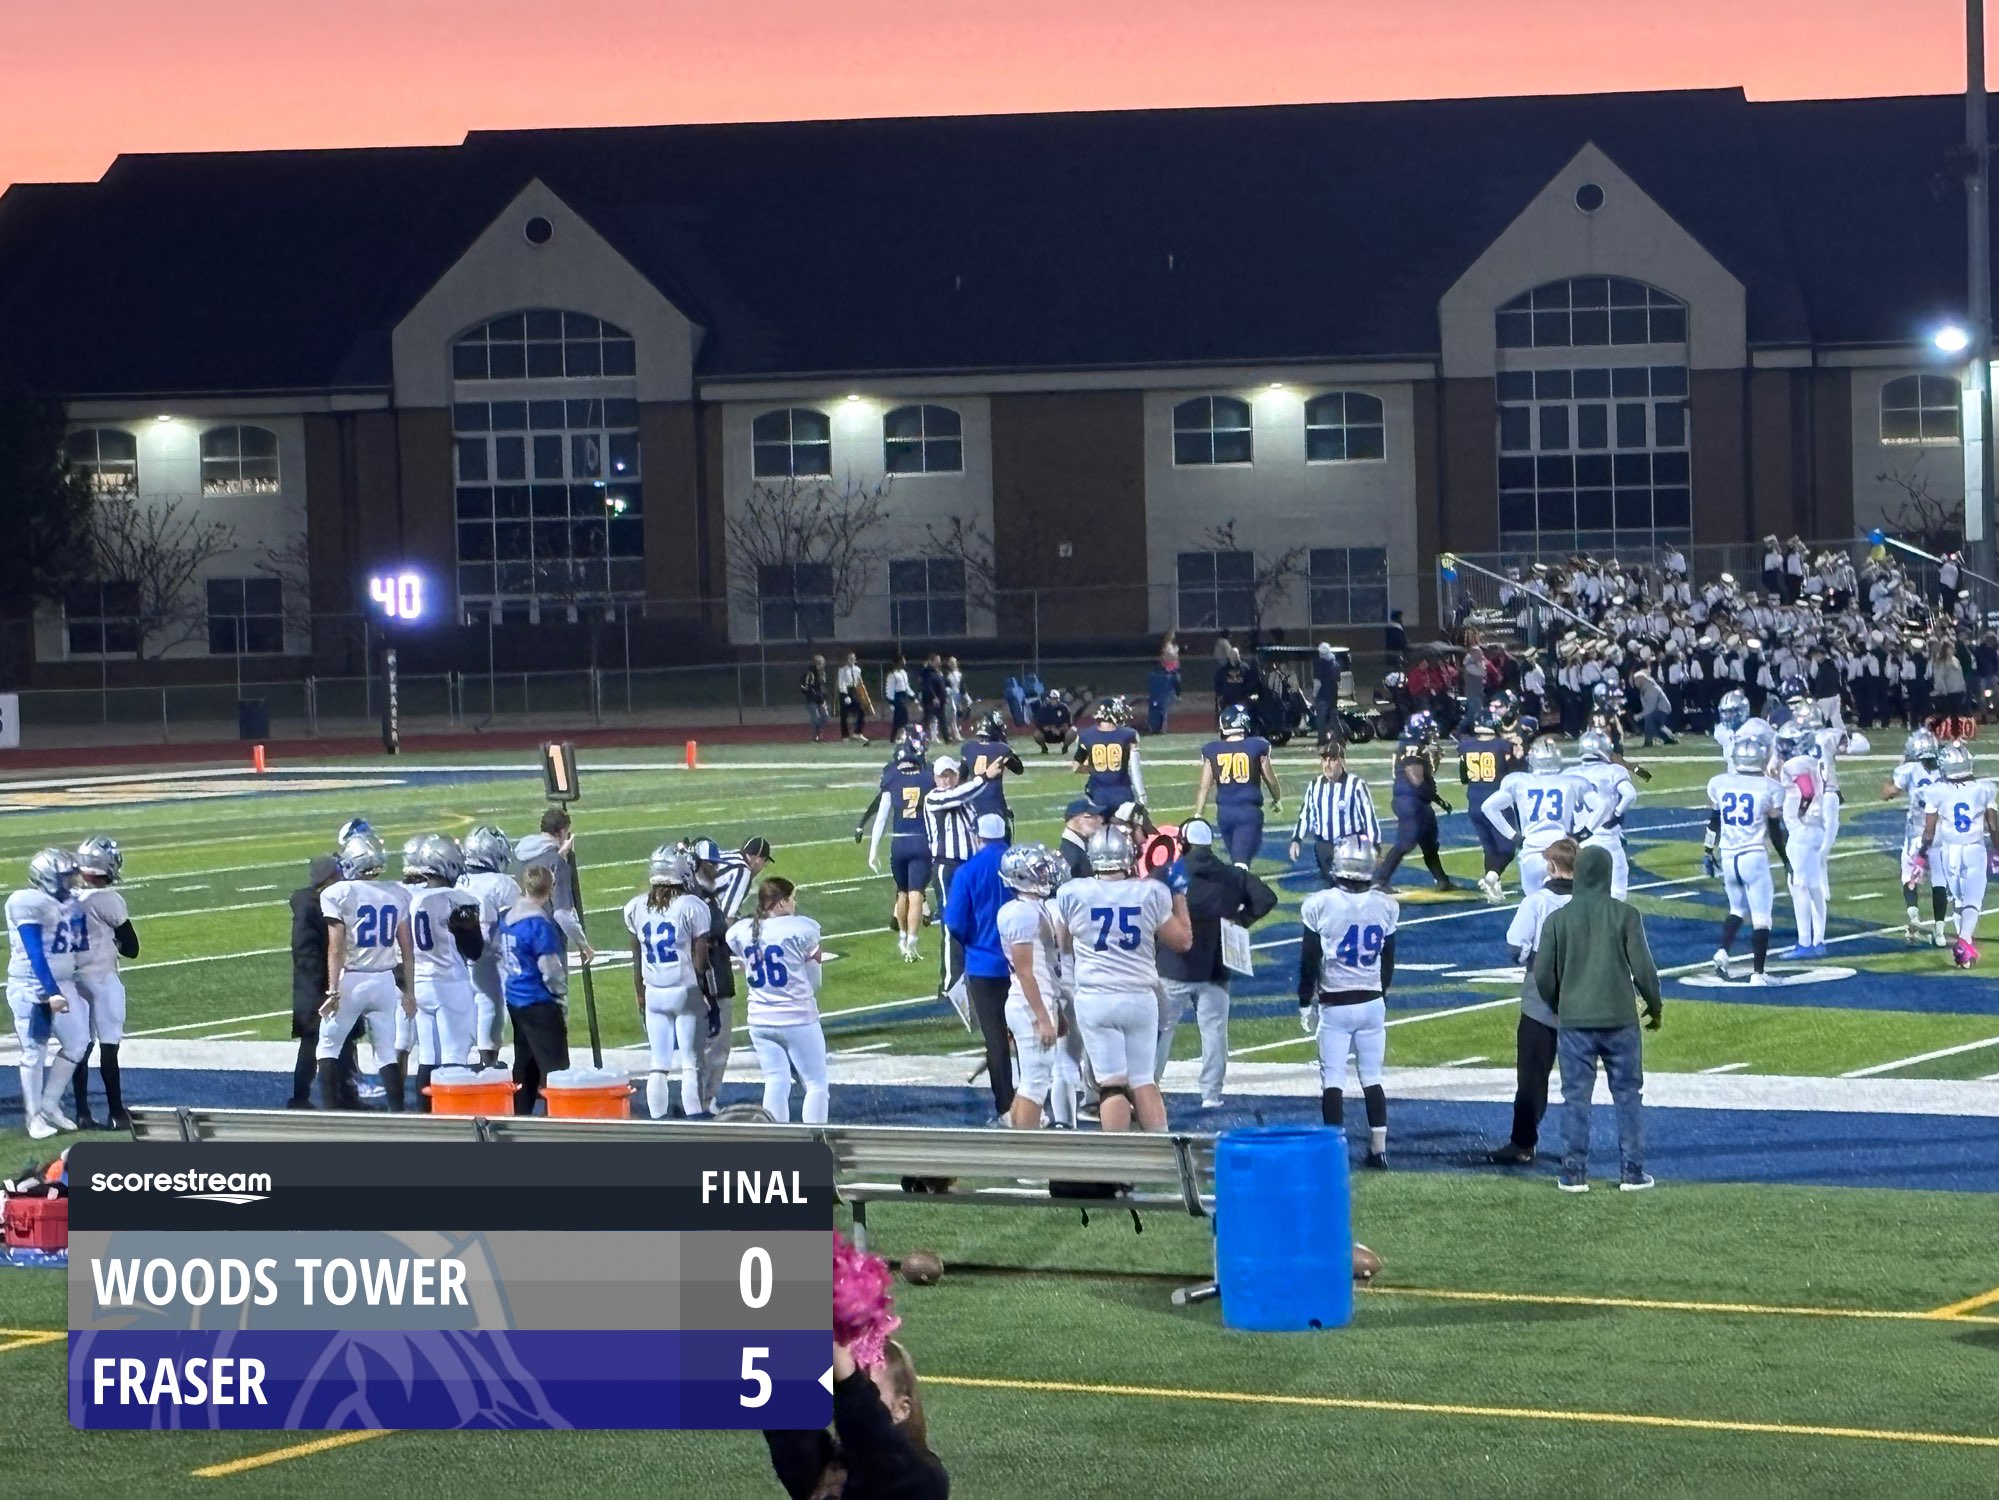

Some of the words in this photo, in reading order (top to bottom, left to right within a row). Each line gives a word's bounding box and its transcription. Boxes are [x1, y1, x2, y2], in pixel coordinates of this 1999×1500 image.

[371, 575, 420, 618] 40
[549, 744, 568, 791] 1
[1216, 752, 1249, 784] 70
[1466, 751, 1496, 782] 58
[902, 786, 920, 818] 7
[1527, 788, 1563, 821] 73
[1721, 792, 1754, 826] 23
[1953, 802, 1971, 833] 6
[356, 904, 398, 948] 20
[641, 921, 679, 964] 12
[1090, 906, 1142, 952] 75
[1336, 924, 1384, 967] 49
[744, 944, 788, 989] 36
